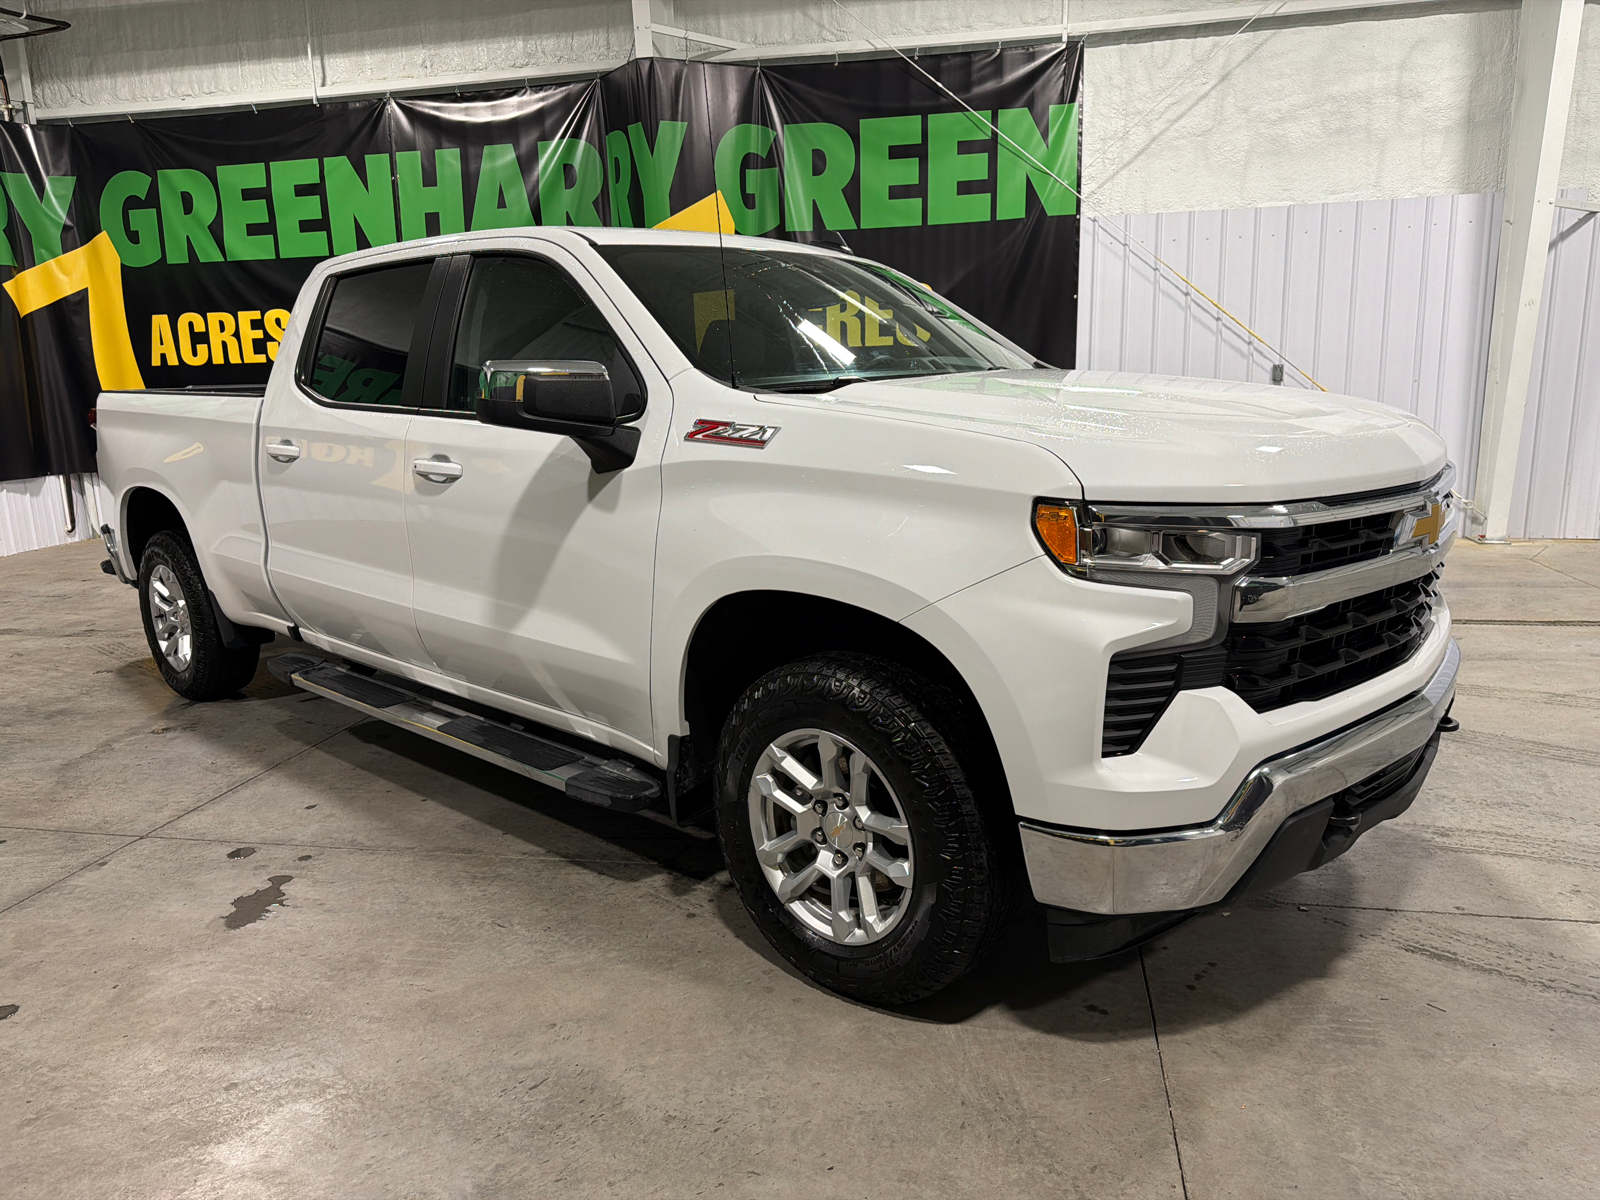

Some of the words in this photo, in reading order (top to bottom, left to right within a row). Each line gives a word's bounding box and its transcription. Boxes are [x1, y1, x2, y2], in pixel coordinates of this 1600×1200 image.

[99, 153, 398, 267] GREEN
[714, 103, 1079, 236] GREEN
[151, 308, 291, 367] ACRES
[684, 419, 781, 450] Z71
